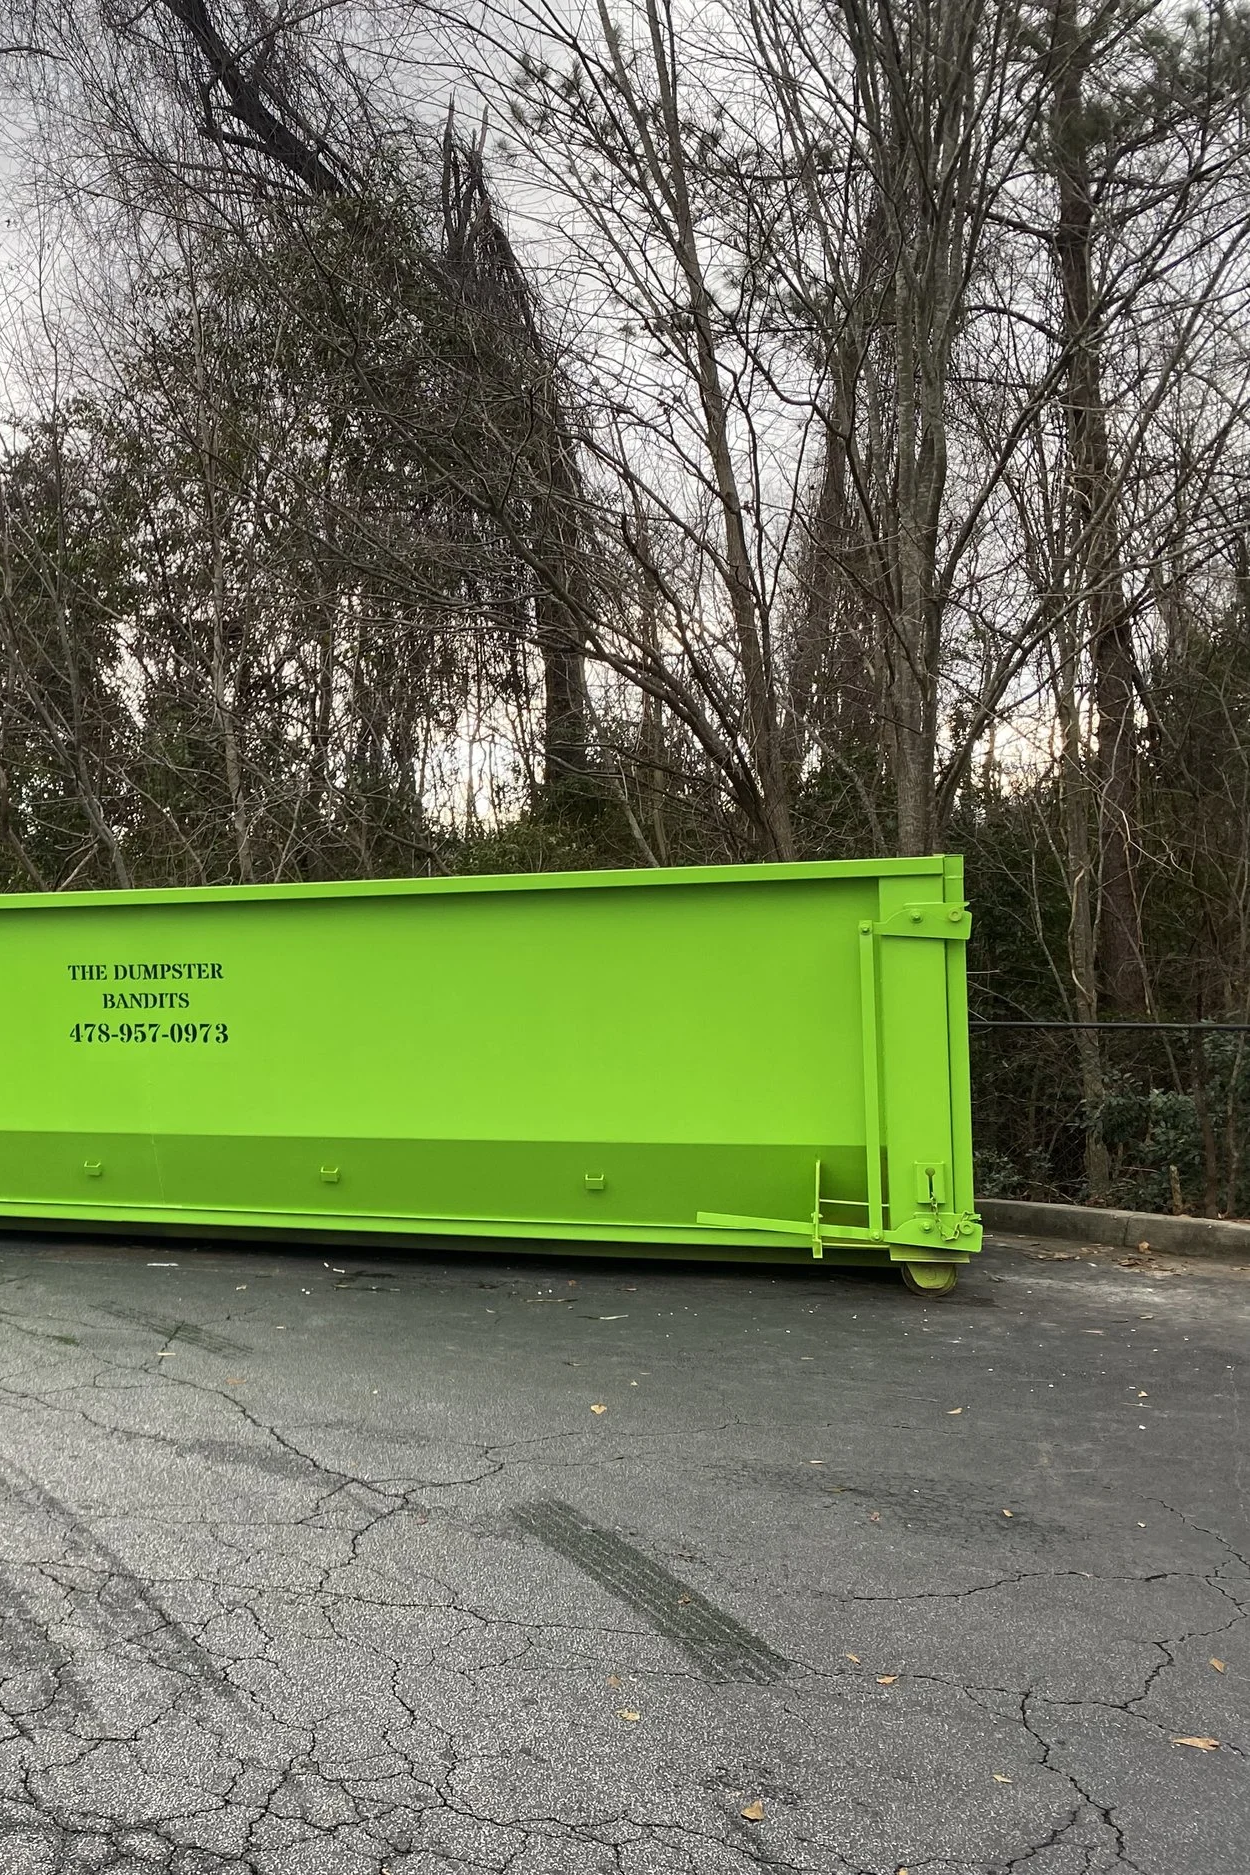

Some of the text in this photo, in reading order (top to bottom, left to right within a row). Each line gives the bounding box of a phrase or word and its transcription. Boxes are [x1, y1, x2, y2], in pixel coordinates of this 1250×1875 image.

[68, 963, 224, 981] THE DUMPSTER
[102, 992, 190, 1009] BANDITS
[69, 1023, 229, 1044] 478-957-0973
